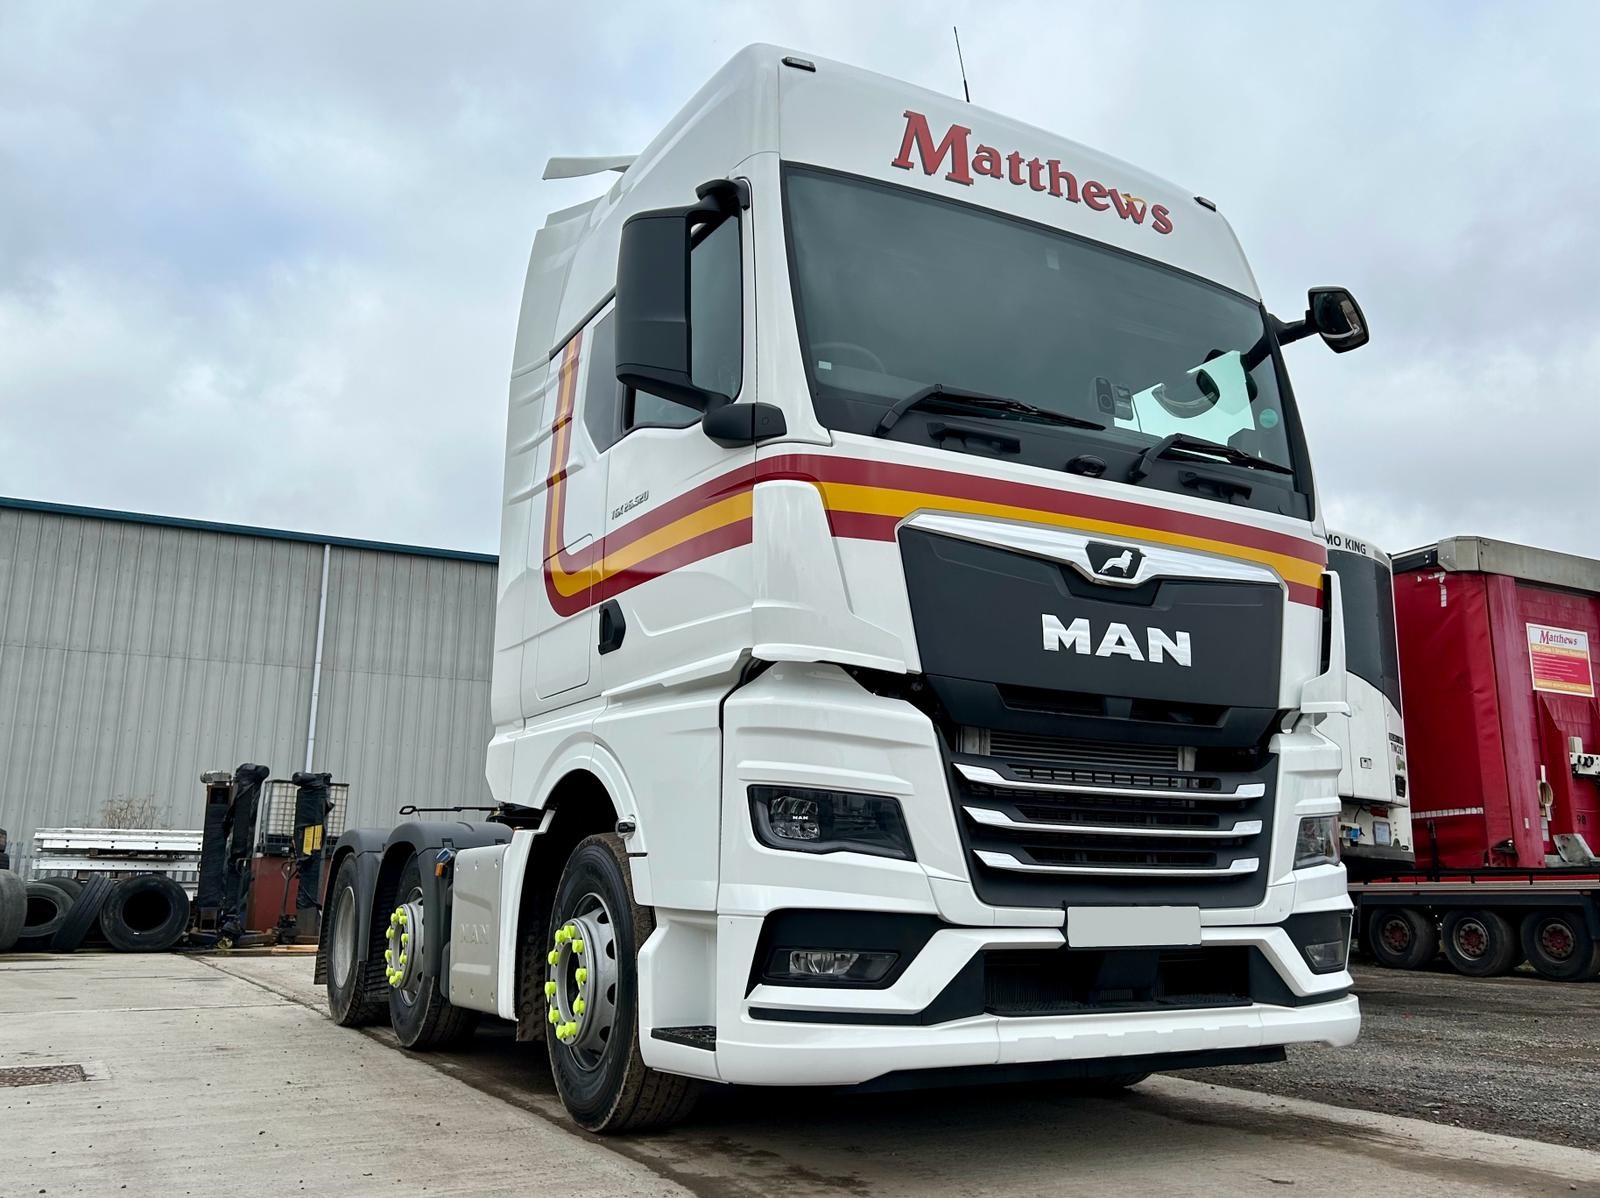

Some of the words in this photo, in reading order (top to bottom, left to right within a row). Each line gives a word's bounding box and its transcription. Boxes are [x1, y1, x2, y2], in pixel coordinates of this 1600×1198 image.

[891, 110, 1173, 234] Matthews
[1345, 537, 1367, 555] KING
[1041, 613, 1192, 667] MAN
[1539, 630, 1578, 645] Matthews
